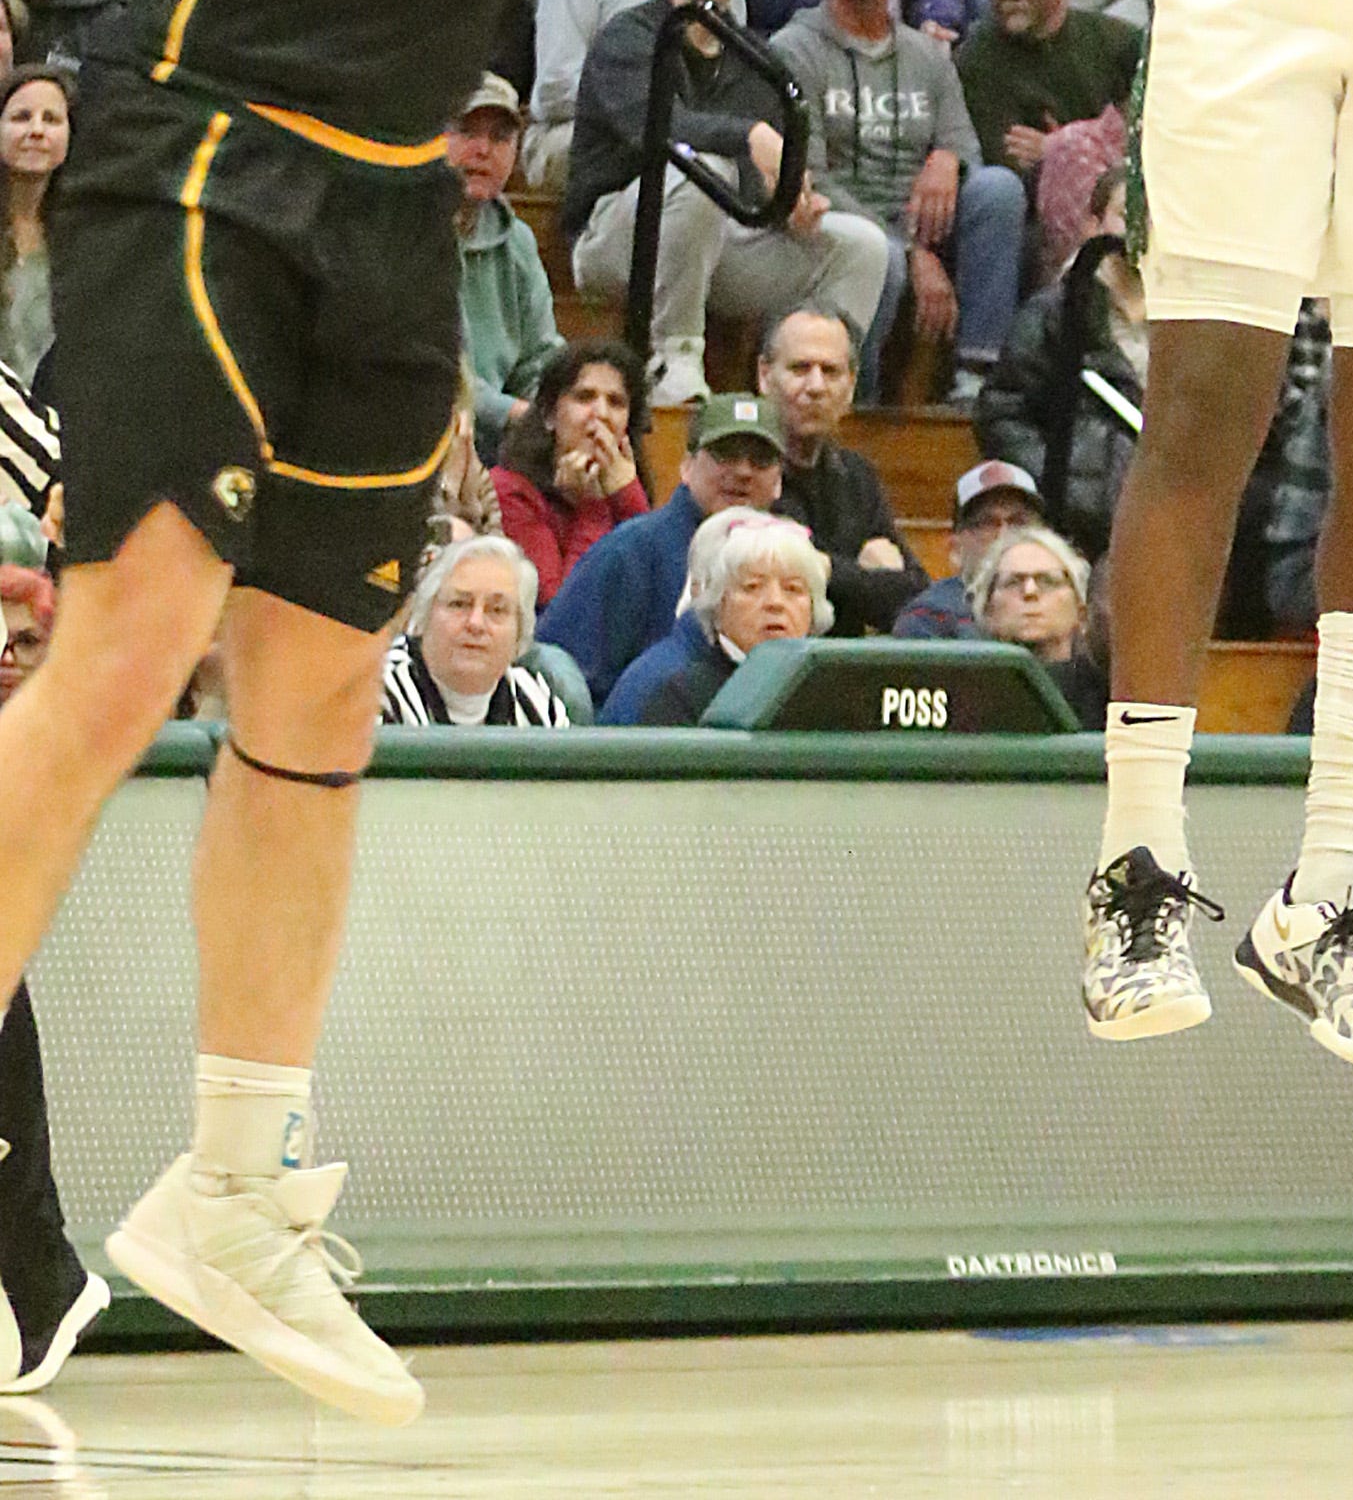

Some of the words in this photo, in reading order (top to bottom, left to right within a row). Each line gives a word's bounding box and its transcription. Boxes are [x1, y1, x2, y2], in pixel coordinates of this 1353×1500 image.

[825, 86, 931, 119] RICE
[882, 686, 949, 730] POSS
[948, 1251, 1118, 1277] DAKTRONICS
